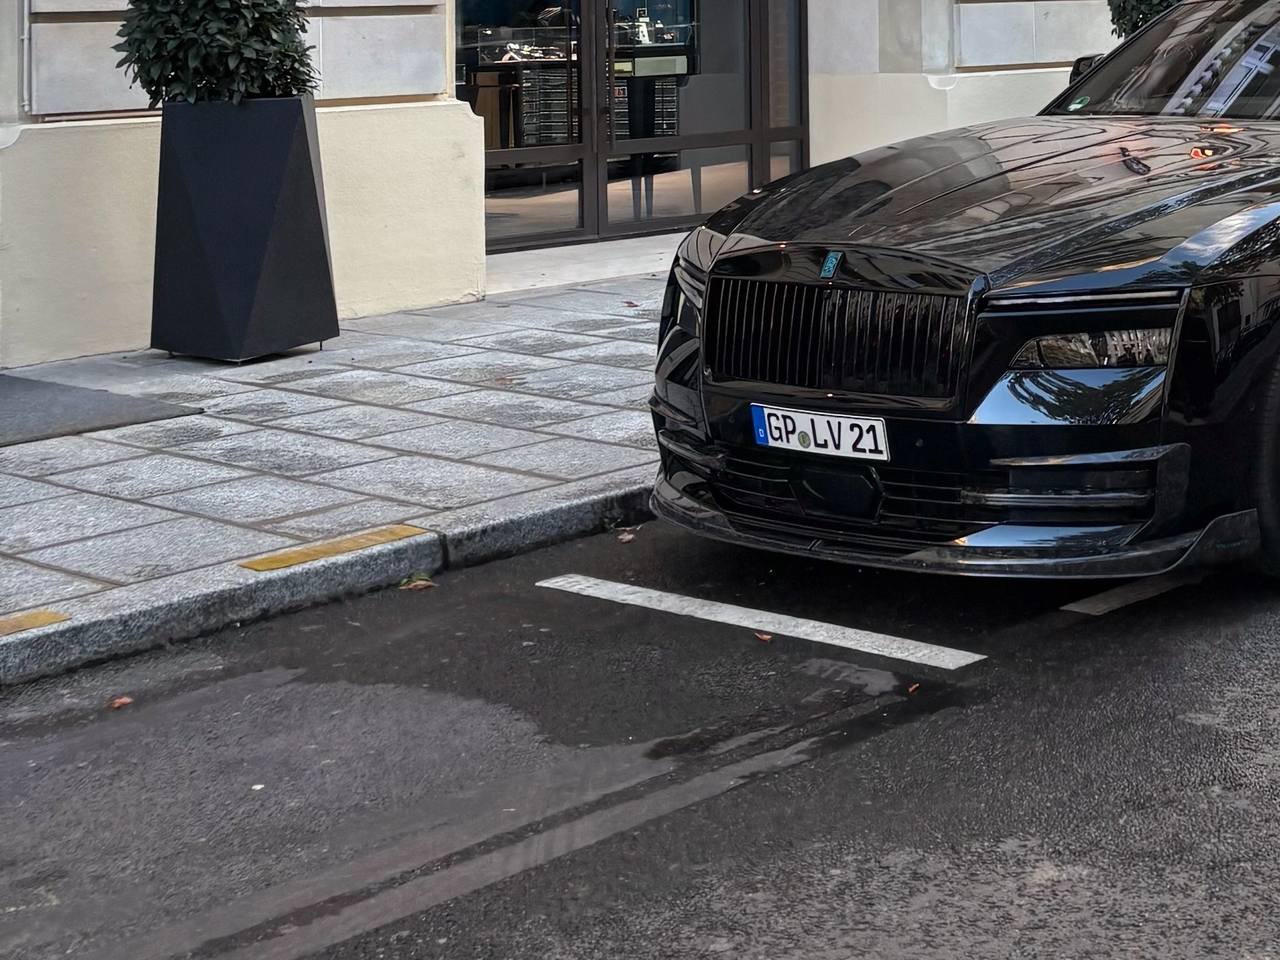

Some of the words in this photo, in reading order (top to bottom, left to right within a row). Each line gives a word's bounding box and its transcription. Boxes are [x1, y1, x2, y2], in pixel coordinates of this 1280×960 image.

[767, 412, 797, 444] GP
[811, 418, 842, 450] LV
[849, 423, 884, 455] 21
